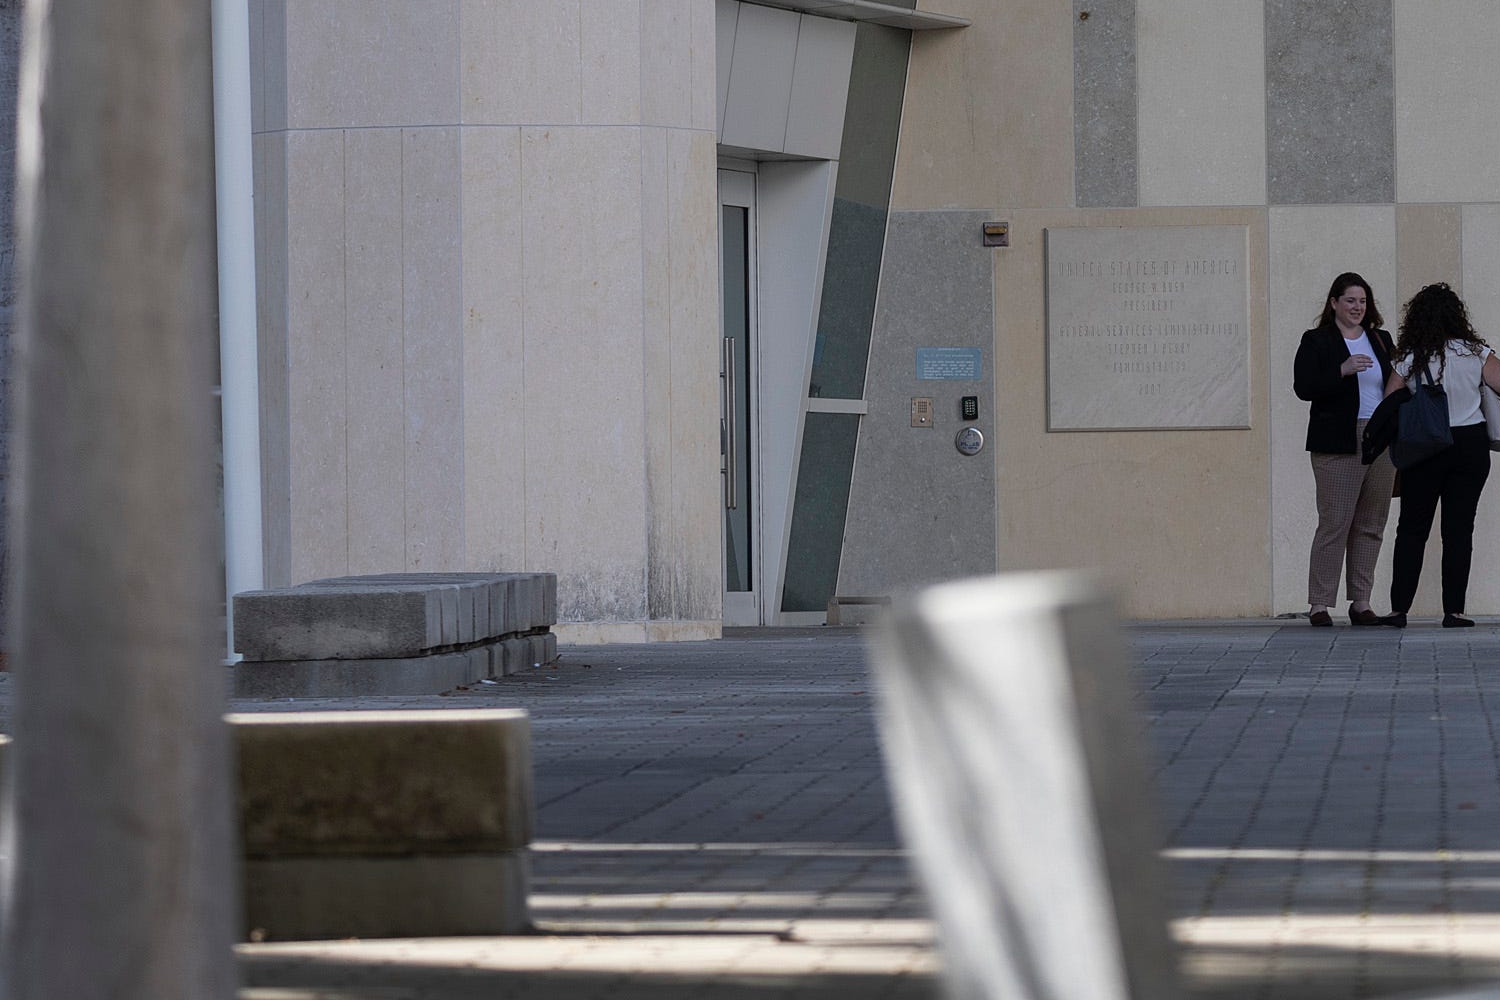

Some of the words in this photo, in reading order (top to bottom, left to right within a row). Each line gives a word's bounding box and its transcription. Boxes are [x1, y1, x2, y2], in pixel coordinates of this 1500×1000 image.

[1058, 262, 1102, 277] UNITED
[1111, 260, 1156, 276] STATES
[1185, 259, 1238, 275] AMERICA
[1060, 325, 1101, 337] GENERAL
[1106, 324, 1153, 337] SERVICES
